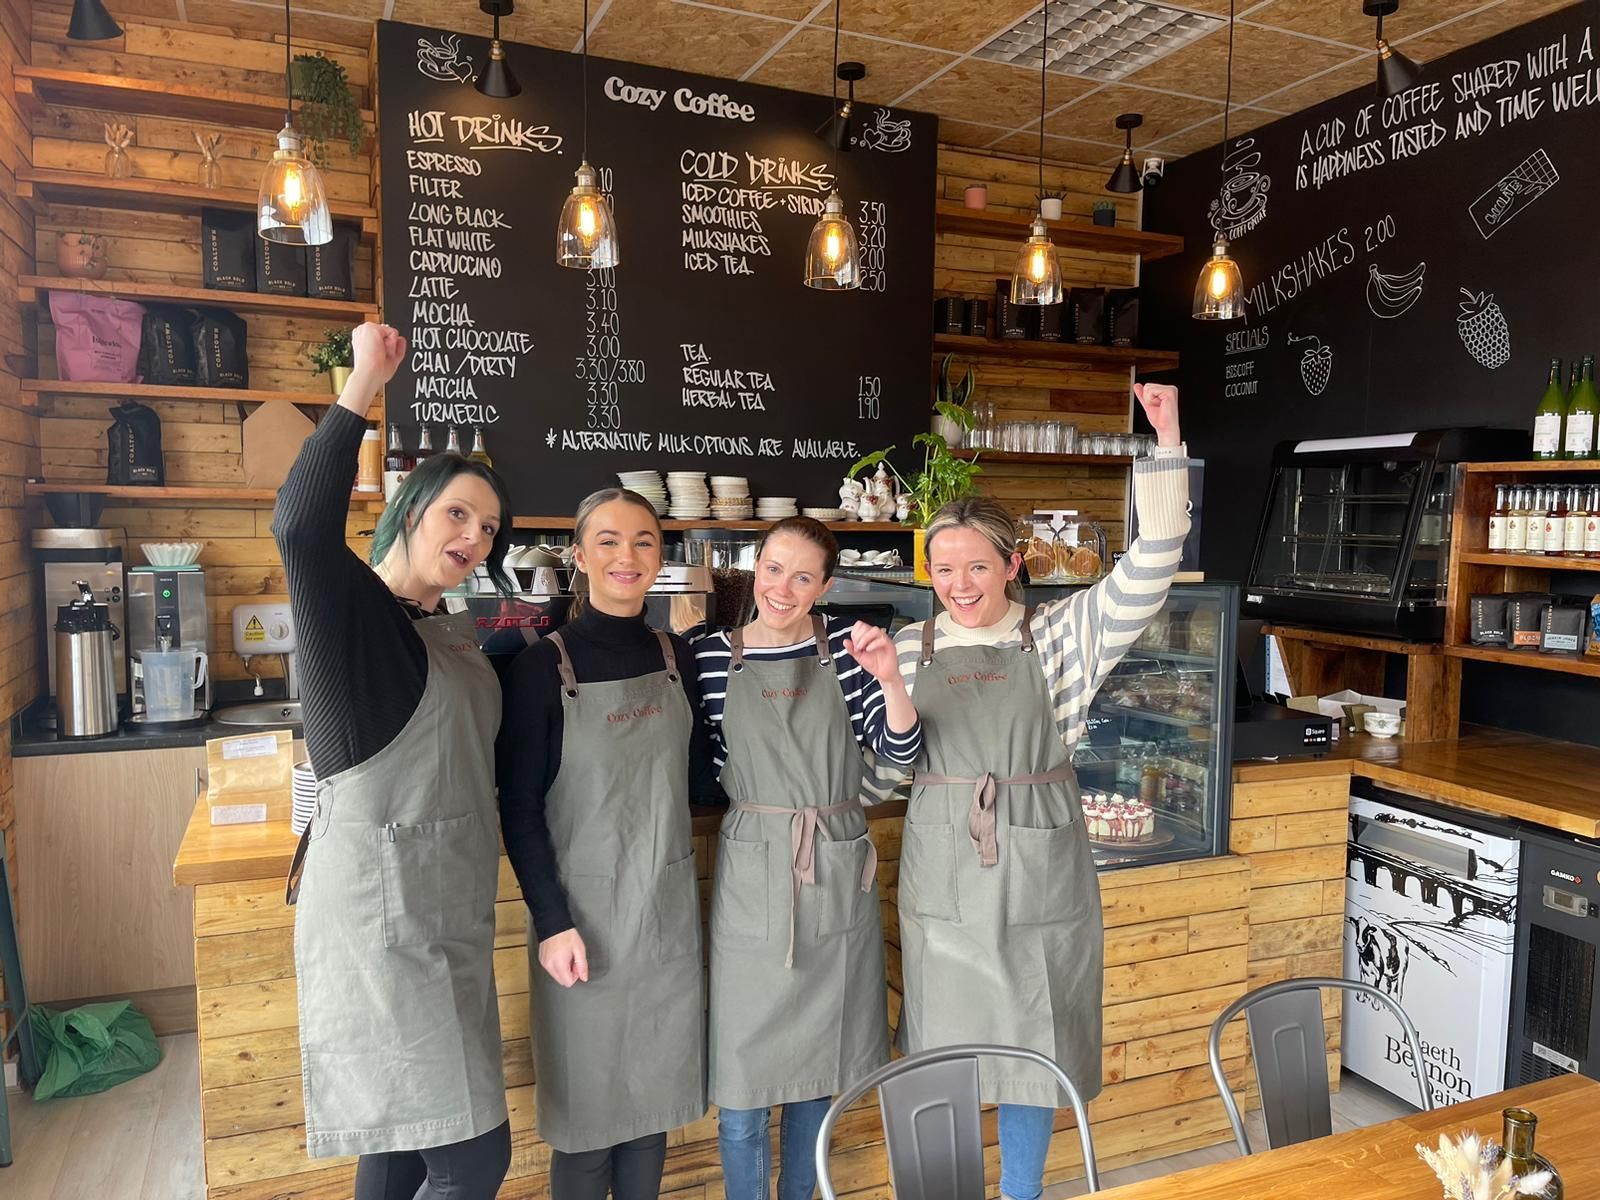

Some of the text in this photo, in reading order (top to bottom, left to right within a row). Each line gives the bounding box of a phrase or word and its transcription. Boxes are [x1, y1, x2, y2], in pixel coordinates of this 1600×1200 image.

[604, 76, 756, 122] Cozy Coffee
[1300, 26, 1594, 160] A CUP OF COFFEE SHARED WITH A
[408, 111, 446, 138] HOT
[1296, 164, 1308, 190] IS
[1312, 139, 1386, 190] HAPPINESS
[1389, 118, 1447, 160] TASTED
[1455, 101, 1492, 141] AND
[1496, 87, 1545, 127] TIME
[406, 150, 482, 176] ESPRESSO
[680, 149, 739, 179] COLD
[409, 174, 463, 199] FILTER
[682, 182, 716, 203] ICED
[718, 187, 778, 210] COFFEE
[787, 193, 825, 218] SYRUP
[859, 200, 886, 226] 3.50
[408, 202, 513, 230] LONG BLACK
[681, 203, 763, 234] SMOOTHIES
[408, 226, 495, 252] FLAT WHITE
[682, 228, 771, 256] MILKSHAKES
[859, 225, 886, 249] 3.20
[211, 229, 219, 272] COALTOWN
[684, 252, 754, 275] ICED TEA
[859, 246, 885, 270] 2.00
[410, 250, 501, 278] CAPPUCCINO
[586, 265, 616, 288] 3.00
[1243, 214, 1396, 326] MILKSHAKES 2.00
[408, 276, 460, 299] LATTE
[586, 288, 618, 312] 3.10
[412, 301, 475, 327] MOCHA
[586, 312, 620, 335] 3.40
[165, 322, 174, 364] COALTOWN
[214, 328, 222, 368] COALTOWN
[411, 327, 534, 354] HOT CHOCOLATE
[586, 335, 621, 358] 3.00
[1226, 325, 1270, 351] SPECIALS
[411, 352, 451, 375] CHAI
[1226, 361, 1255, 379] BISCOFF
[415, 377, 478, 400] MATCHA
[682, 367, 776, 392] REGULAR TEA
[1225, 380, 1258, 397] COCONUT
[587, 381, 618, 406] 3.30
[682, 388, 766, 412] HERBAL TEA
[410, 402, 500, 424] TURMERIC
[587, 405, 621, 429] 3.30
[127, 424, 135, 464] COALTO
[561, 429, 652, 452] ALTERNATIVE
[658, 433, 693, 453] MILK
[694, 435, 754, 456] OPTIONS
[757, 438, 784, 457] ARE
[1550, 869, 1575, 882] GAMKO
[1384, 1034, 1472, 1099] Benon
